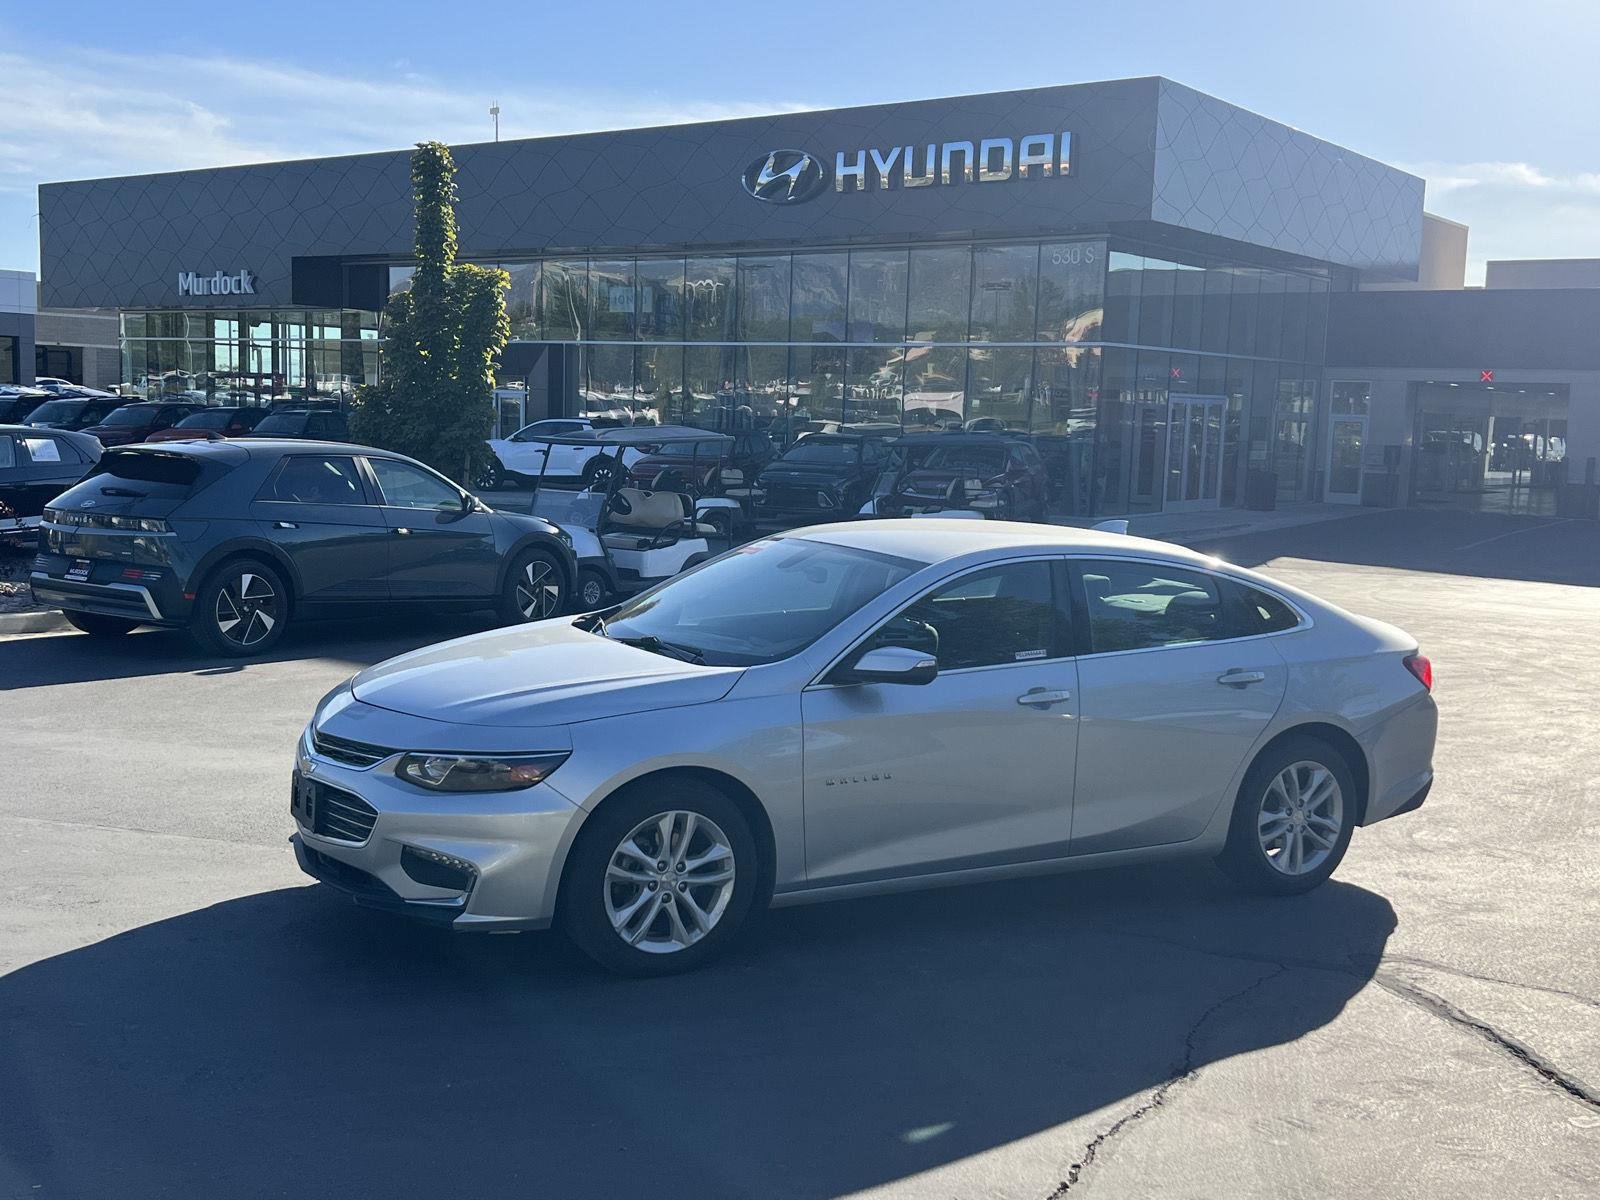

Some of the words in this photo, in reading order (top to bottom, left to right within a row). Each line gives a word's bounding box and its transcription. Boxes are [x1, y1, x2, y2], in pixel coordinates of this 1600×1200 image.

[835, 131, 1072, 193] HYUNDAI
[1052, 247, 1081, 265] 530
[1085, 247, 1095, 264] S
[178, 269, 255, 296] Murdock
